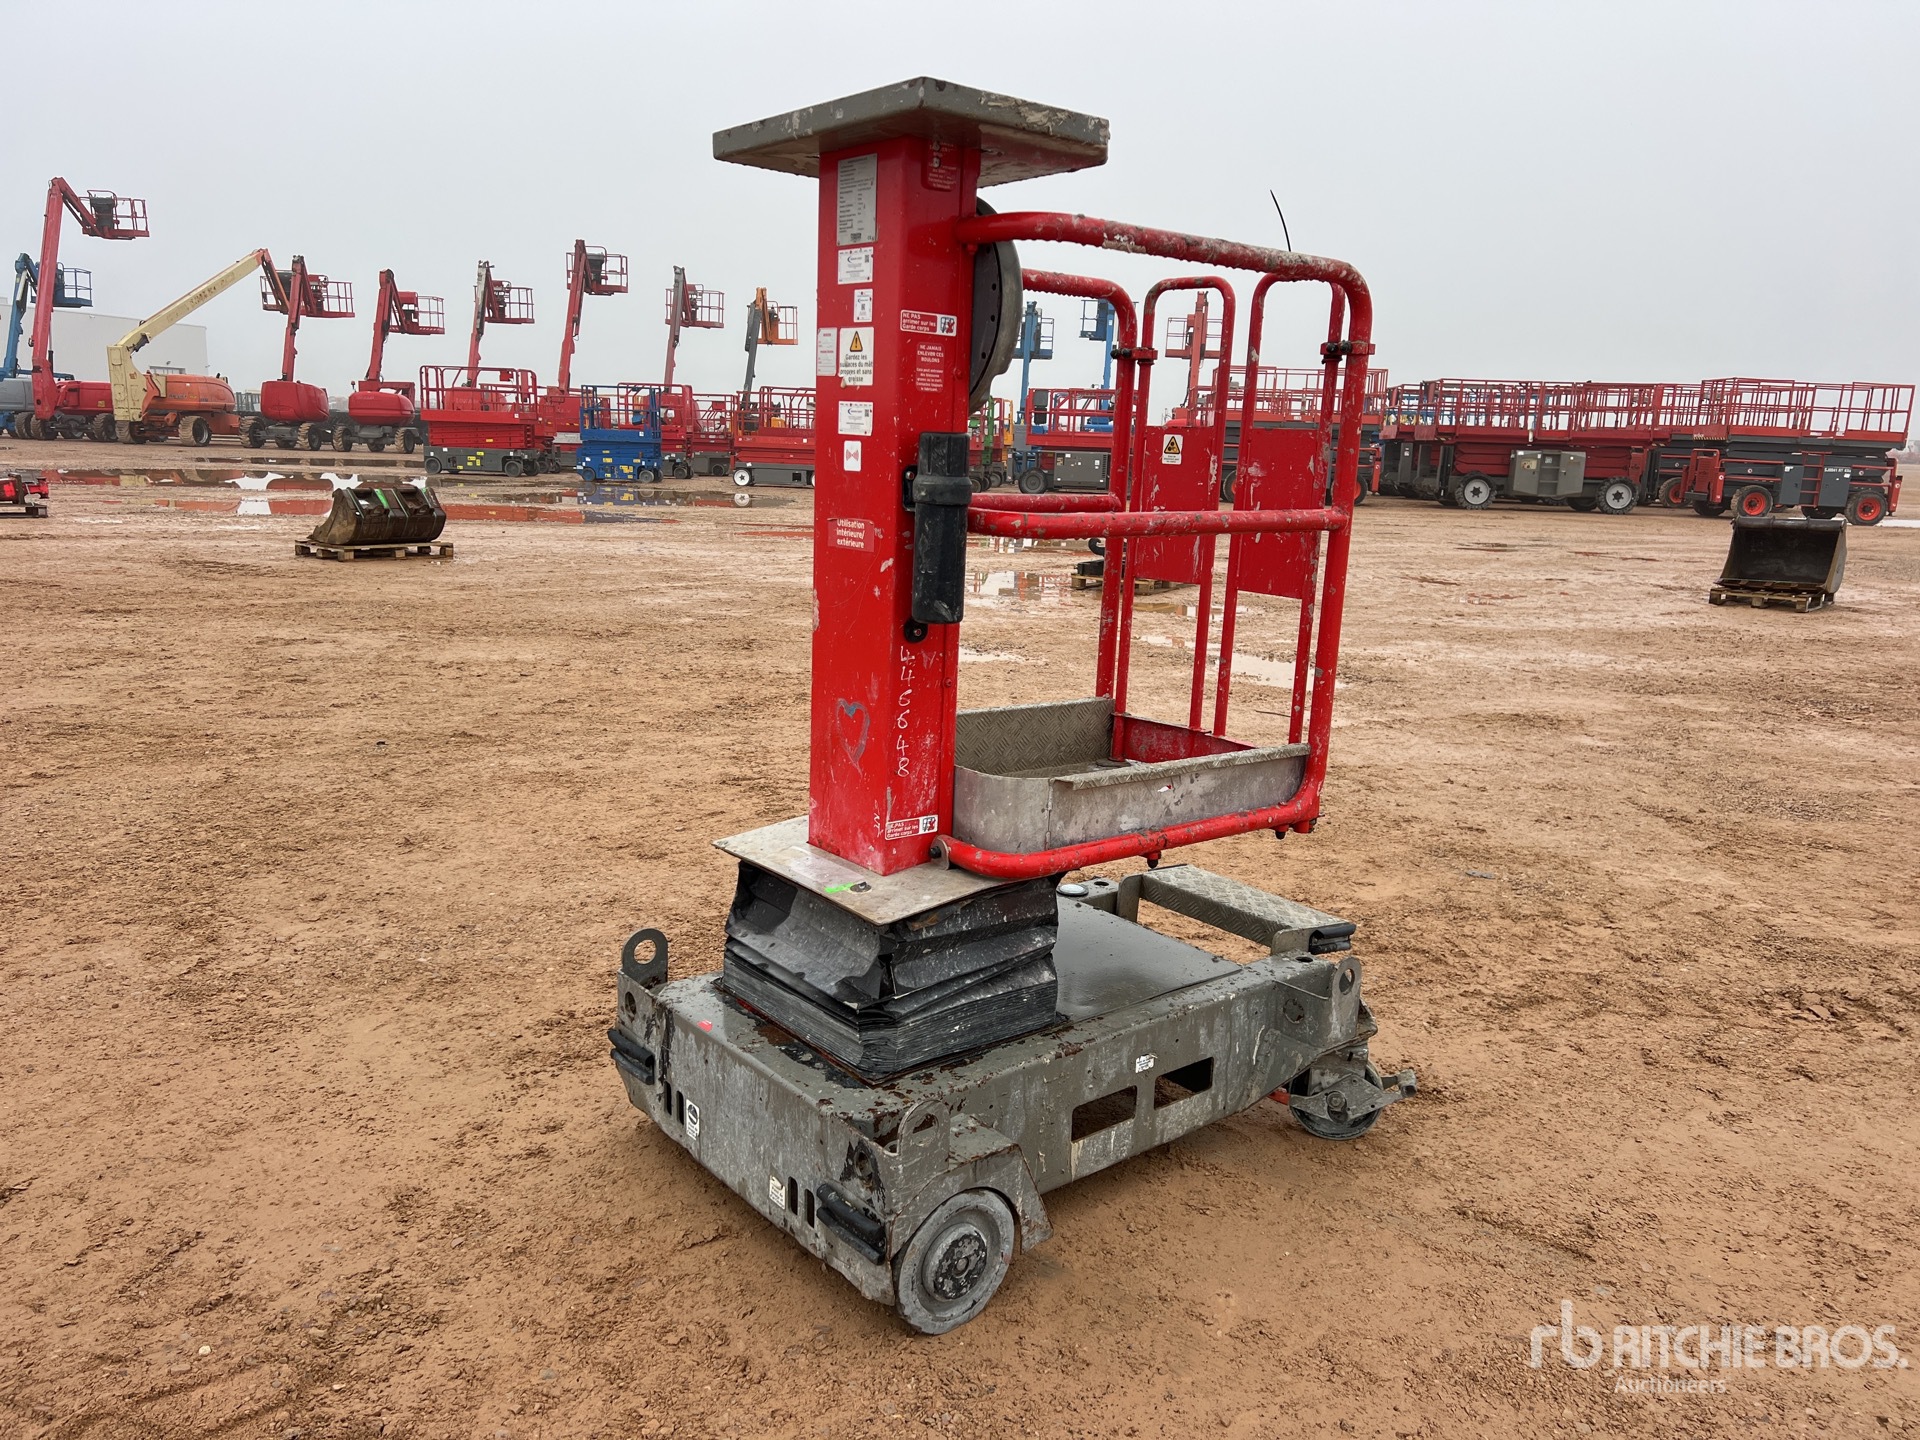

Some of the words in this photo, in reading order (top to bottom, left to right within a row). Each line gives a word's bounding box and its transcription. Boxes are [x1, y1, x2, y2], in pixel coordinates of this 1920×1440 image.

[836, 518, 865, 530] Utilisation
[836, 528, 866, 540] intérieure/
[836, 538, 865, 548] extérieure
